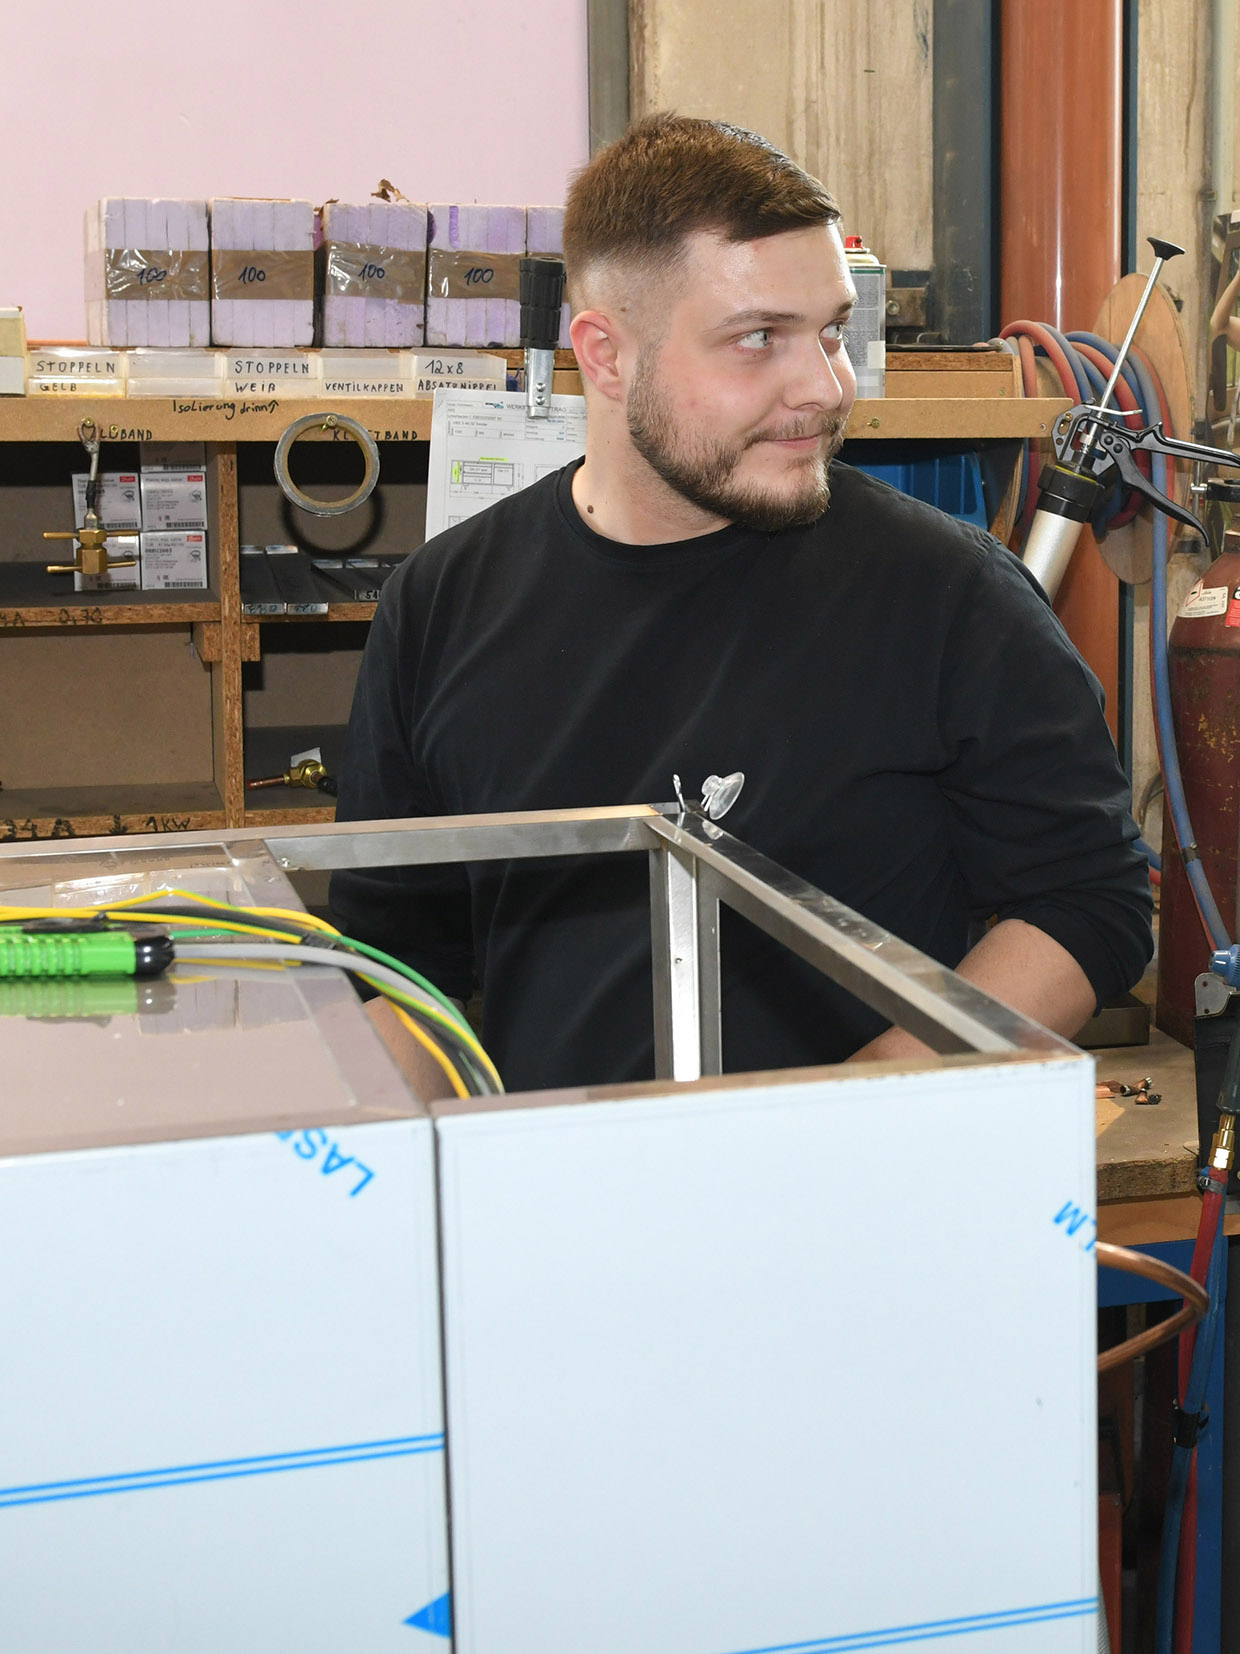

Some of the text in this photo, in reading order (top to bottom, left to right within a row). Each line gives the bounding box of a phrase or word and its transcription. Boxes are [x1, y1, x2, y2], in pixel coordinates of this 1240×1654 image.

[137, 267, 168, 285] 100
[238, 266, 266, 285] 100
[358, 263, 386, 281] 100
[464, 268, 495, 285] 100
[36, 360, 115, 374] STOPPELN
[235, 360, 309, 374] STOPPELN
[40, 382, 77, 392] GELB
[100, 428, 153, 441] LUBAND
[333, 429, 418, 441] KLTBAND
